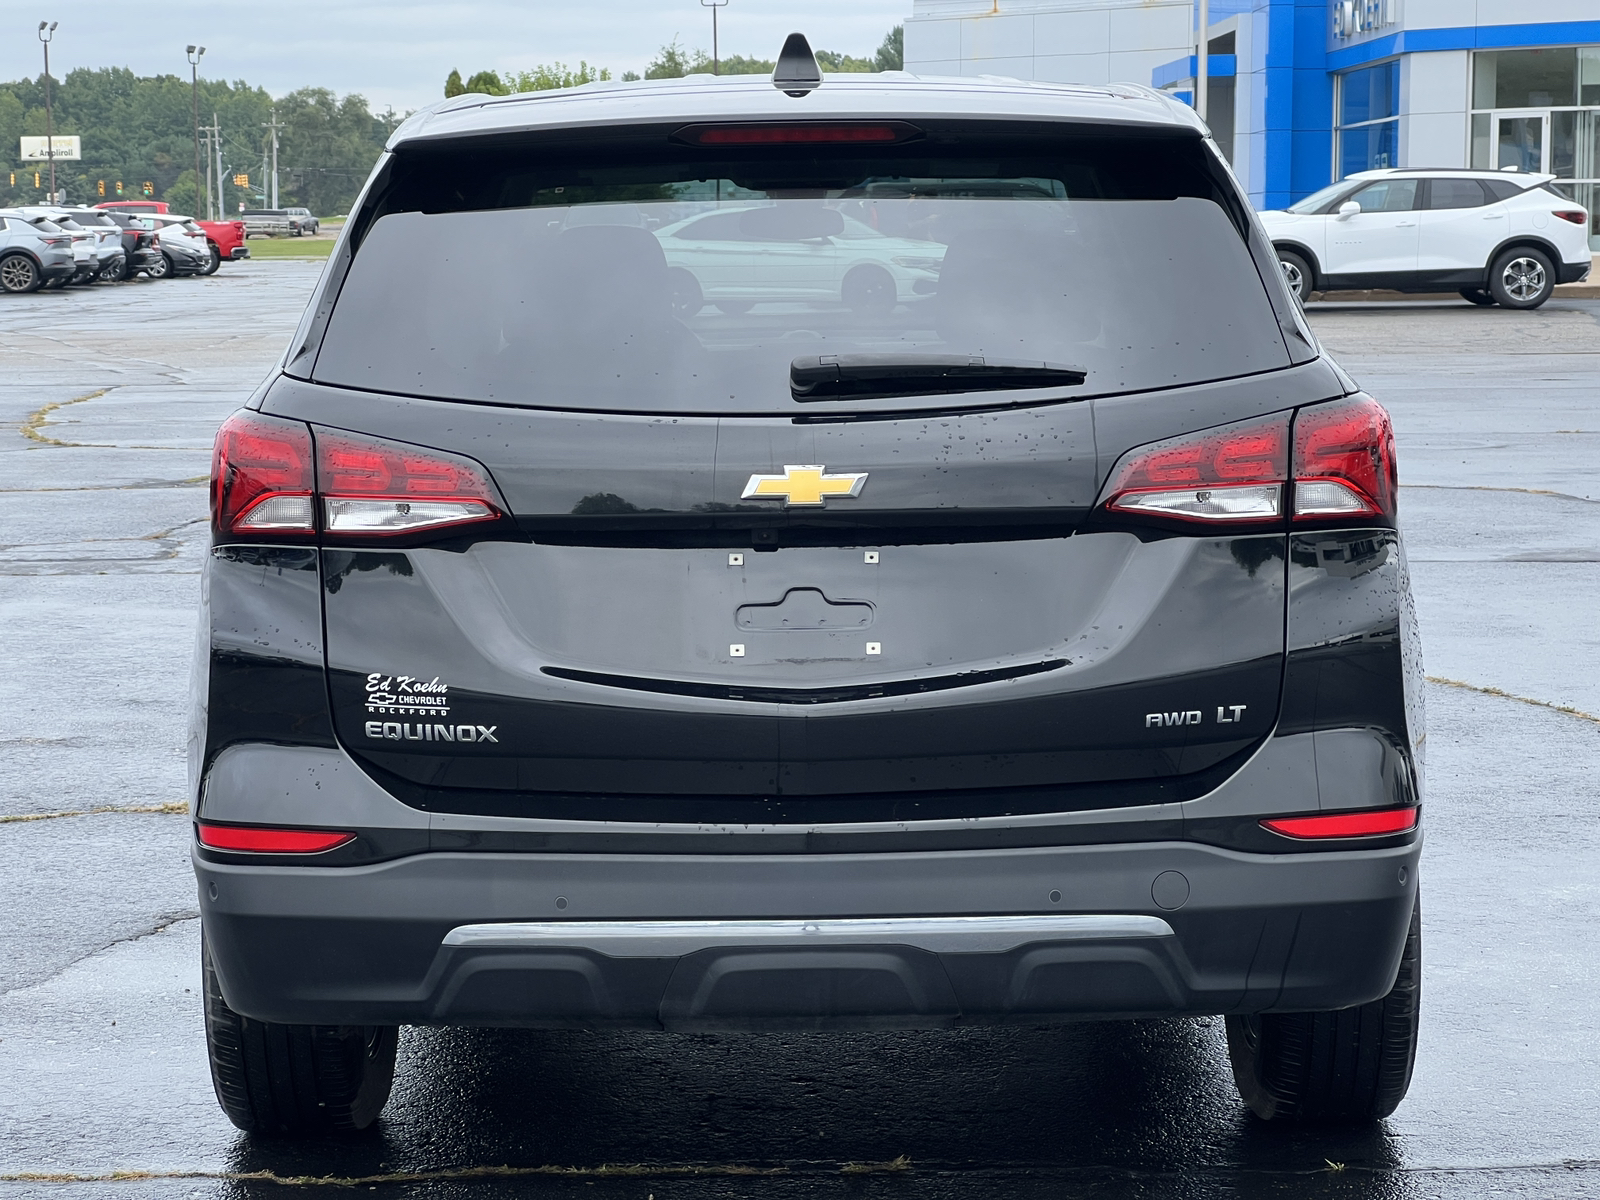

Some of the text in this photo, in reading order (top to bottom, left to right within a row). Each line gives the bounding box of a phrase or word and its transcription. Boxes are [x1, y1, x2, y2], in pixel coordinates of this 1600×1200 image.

[365, 673, 449, 694] Ed Koehn
[368, 706, 447, 716] ROCKFORD
[398, 695, 447, 706] CHEVROLET
[1145, 704, 1247, 728] AWD LT
[365, 721, 499, 743] EQUINOX
